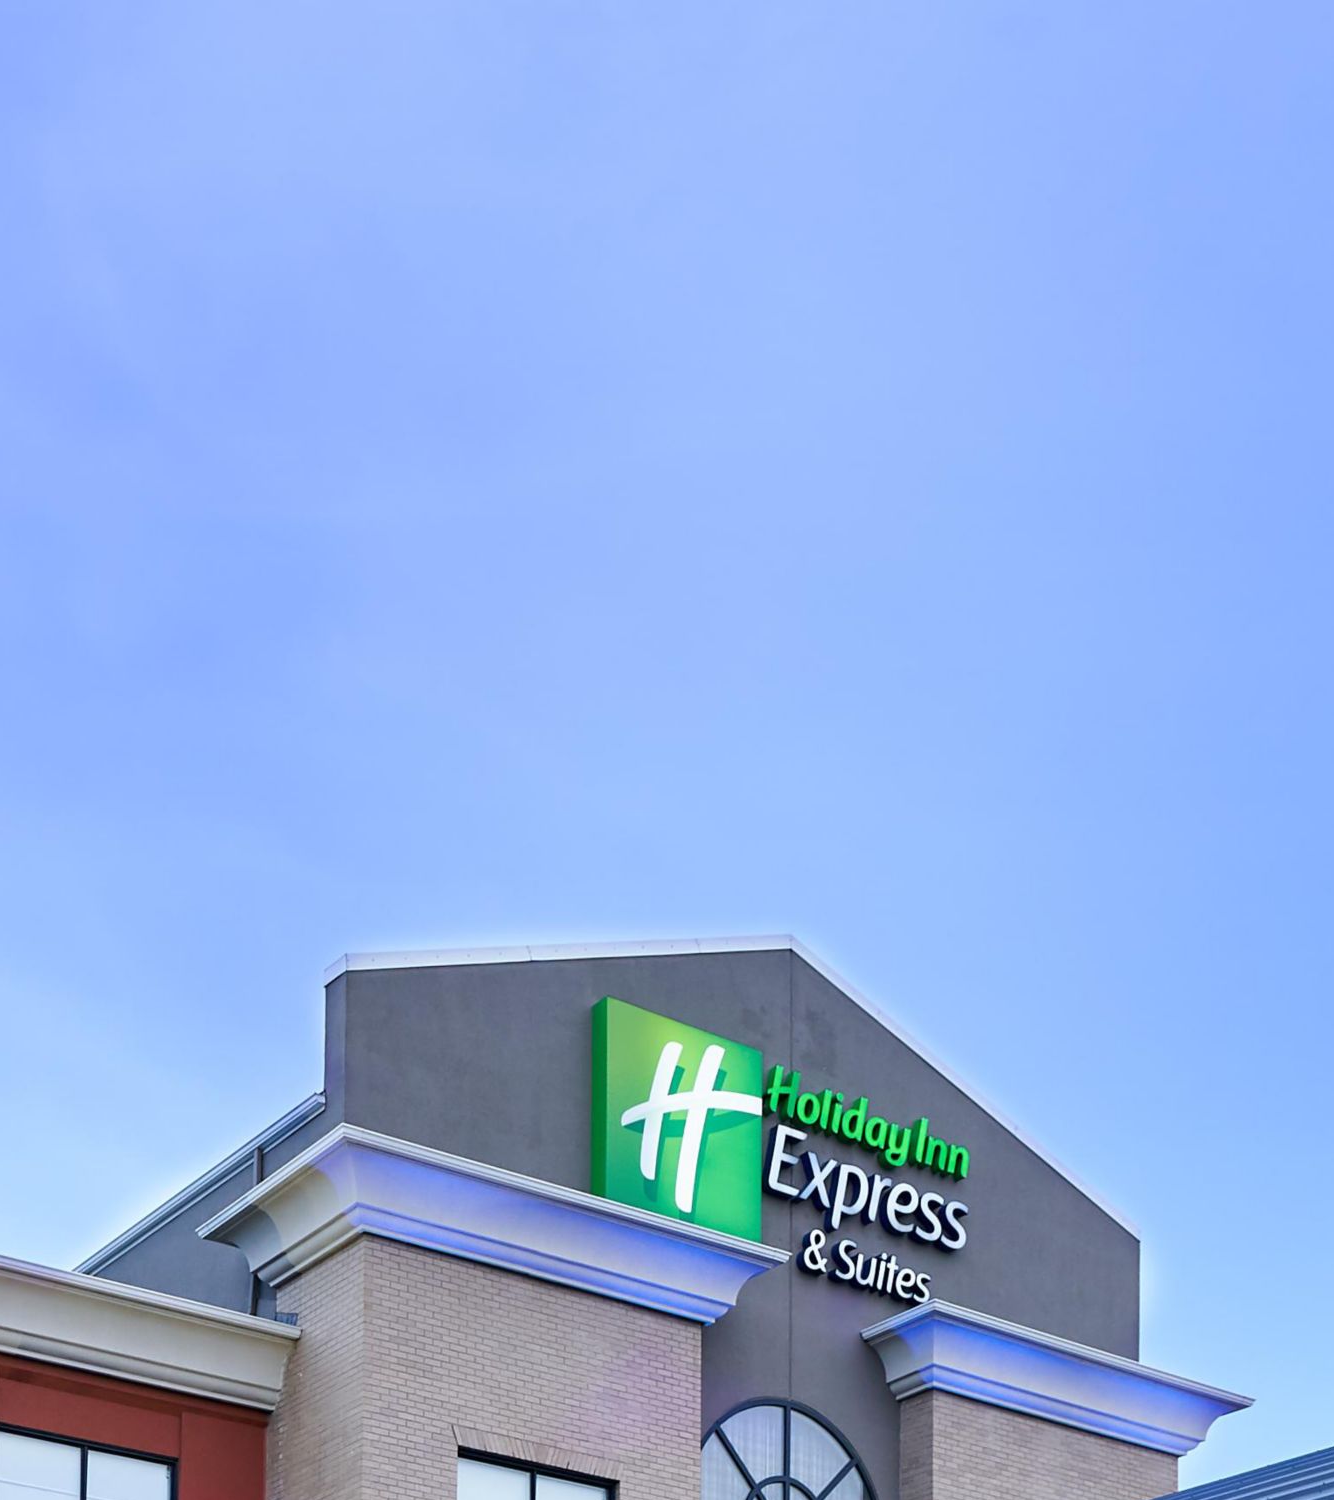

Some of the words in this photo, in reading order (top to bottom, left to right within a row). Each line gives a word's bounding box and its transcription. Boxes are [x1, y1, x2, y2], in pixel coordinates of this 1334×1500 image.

[768, 1065, 911, 1167] Holiday
[916, 1117, 970, 1179] Inn
[768, 1124, 968, 1250] Express
[804, 1229, 827, 1272] &
[835, 1240, 931, 1302] Suites
